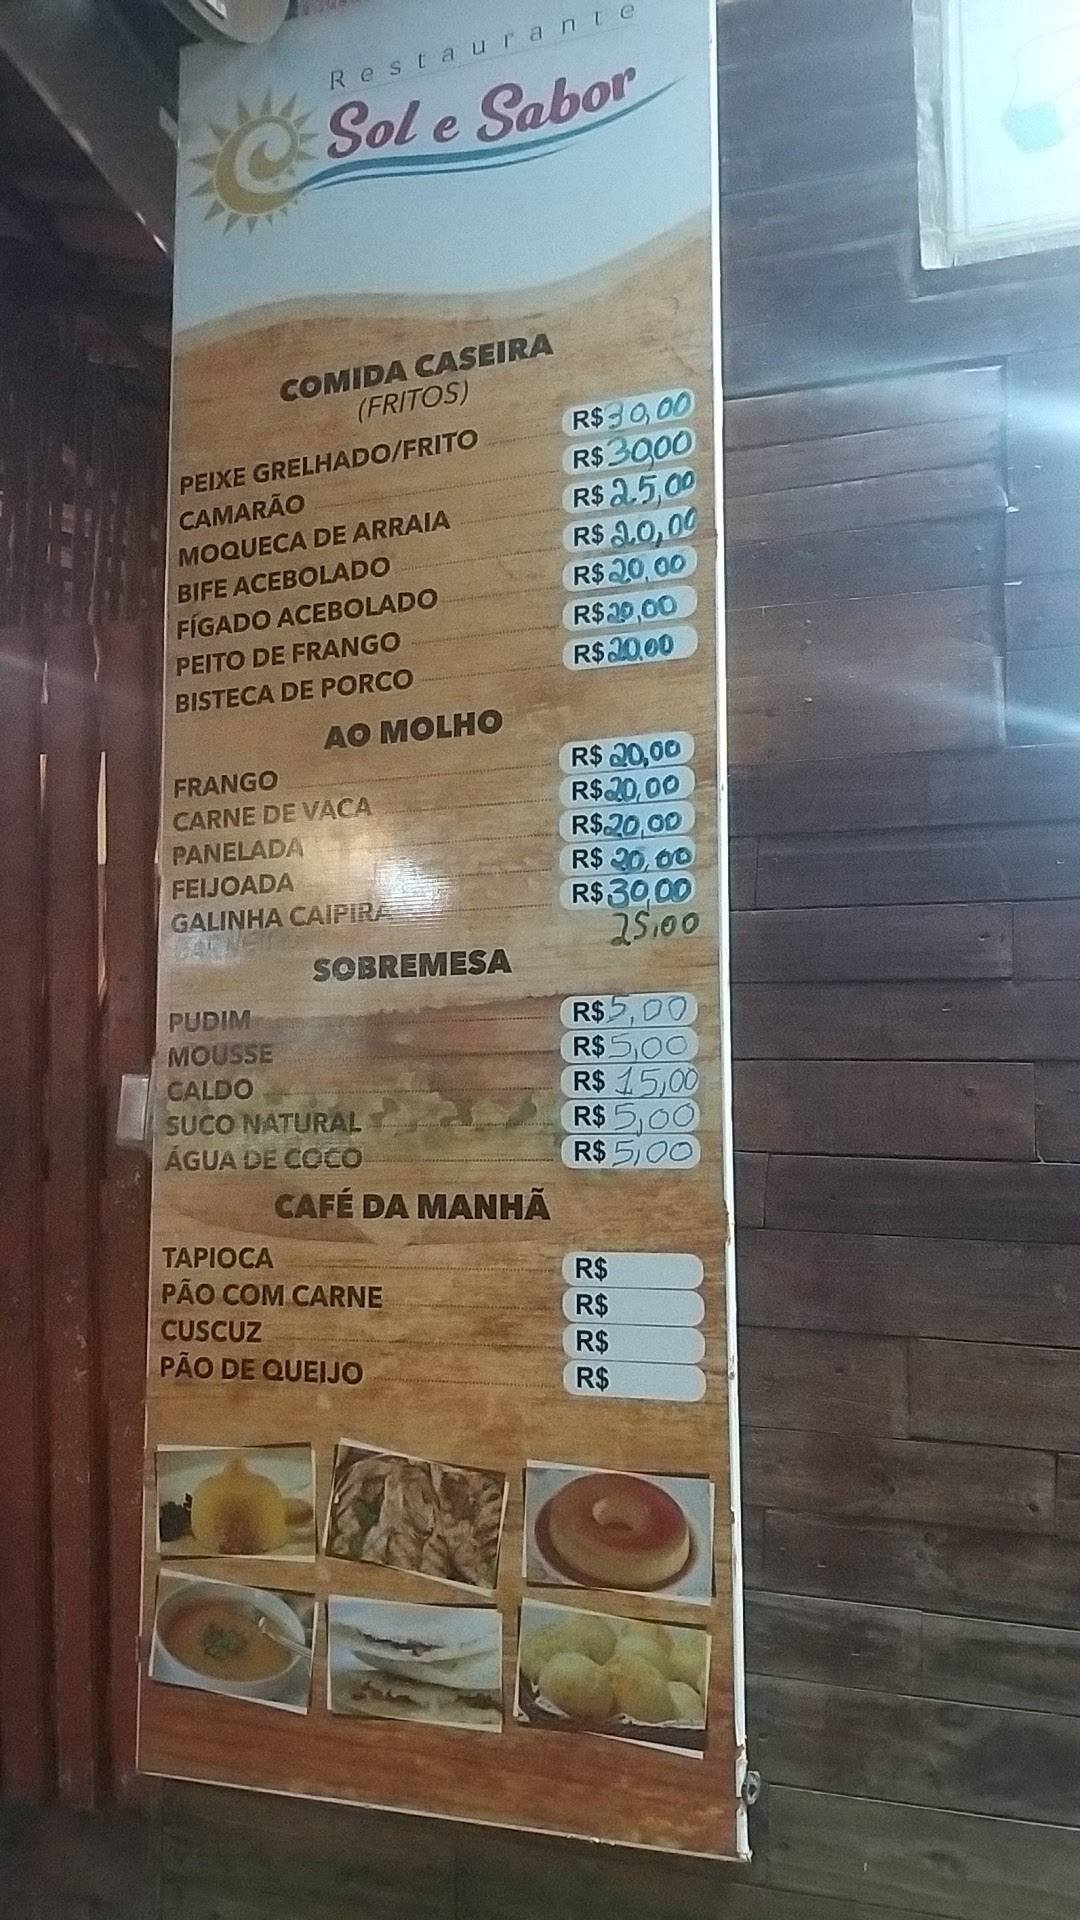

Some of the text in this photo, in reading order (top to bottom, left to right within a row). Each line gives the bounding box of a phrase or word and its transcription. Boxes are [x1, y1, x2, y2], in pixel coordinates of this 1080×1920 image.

[330, 3, 636, 91] Restaurante
[327, 66, 637, 159] Sol e Sabor
[280, 333, 554, 402] COMIDA CASEIRA
[358, 380, 469, 423] (FRITOS)
[180, 429, 479, 495] PEIXE GRELHADO/FRITO
[179, 493, 305, 531] CAMARÃO
[178, 510, 451, 567] MOQUECA DE ARRAIA
[178, 556, 391, 604] BIFE ACEBOLADO
[177, 588, 438, 640] FÍGADO ACEBOLADO
[176, 631, 401, 677] PEITO DE FRANGO
[175, 668, 414, 714] BISTECA DE PORCO
[324, 709, 503, 751] AO MOLHO
[174, 770, 278, 799] FRANGO
[173, 797, 372, 832] CARNE DE VACA
[172, 837, 304, 866] PANELADA
[172, 872, 294, 900] FEIJOADA
[171, 906, 282, 934] GALINHA
[313, 949, 512, 983] SOBREMESA
[169, 1009, 251, 1033] PUDIM
[168, 1043, 274, 1068] MOUSSE
[167, 1078, 254, 1101] CALDO
[165, 1110, 362, 1137] SUCO NATURAL
[164, 1144, 363, 1172] ÁGUA DE COCO
[274, 1187, 551, 1221] CAFÉ DA MANHÃ
[162, 1246, 274, 1269] TAPIOCA
[575, 1256, 608, 1282] R$
[162, 1278, 383, 1309] PÃO COM CARNE
[576, 1292, 608, 1318] R$
[160, 1319, 262, 1343] CUSCUZ
[576, 1329, 609, 1354] R$
[160, 1352, 364, 1386] PÃO DE QUEIJO
[577, 1366, 609, 1392] R$
